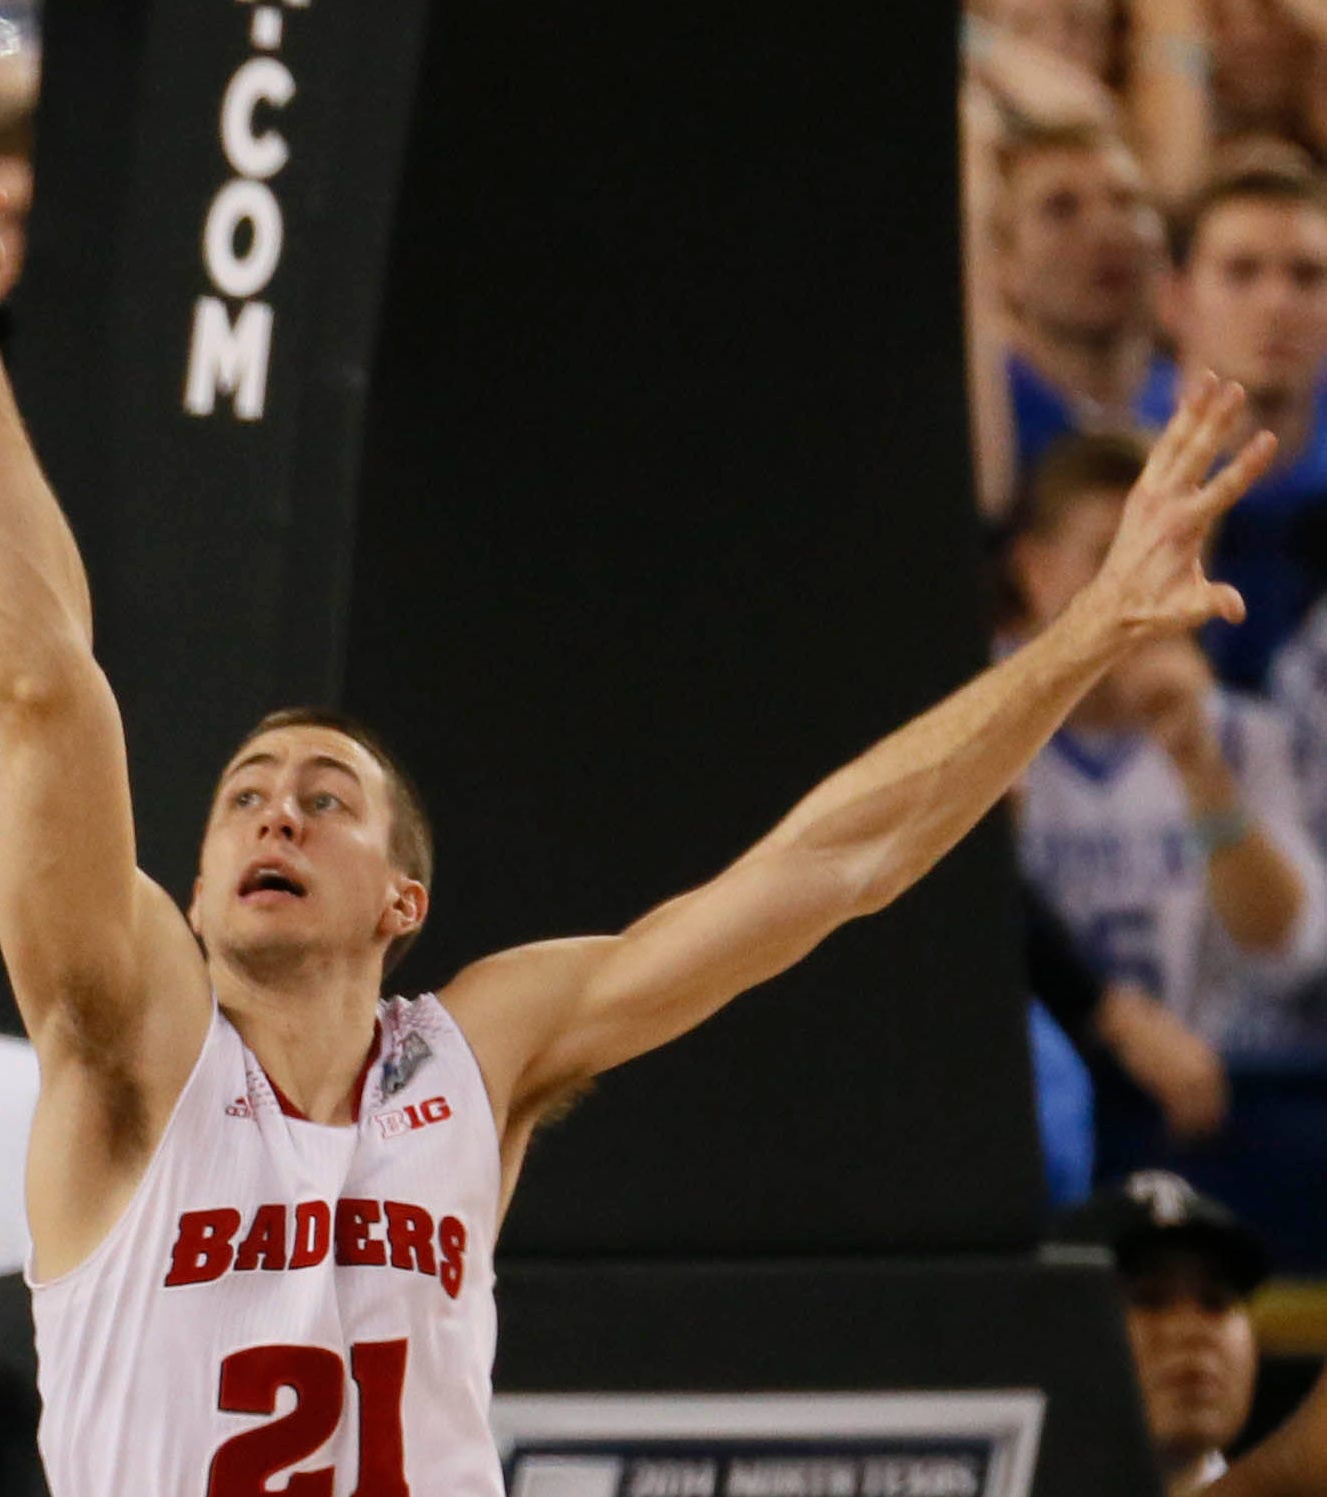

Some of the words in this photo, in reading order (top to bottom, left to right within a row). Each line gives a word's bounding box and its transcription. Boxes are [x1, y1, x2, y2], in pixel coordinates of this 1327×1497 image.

[183, 0, 297, 421] .COM
[164, 1197, 467, 1300] BADERS
[205, 1337, 410, 1497] 21
